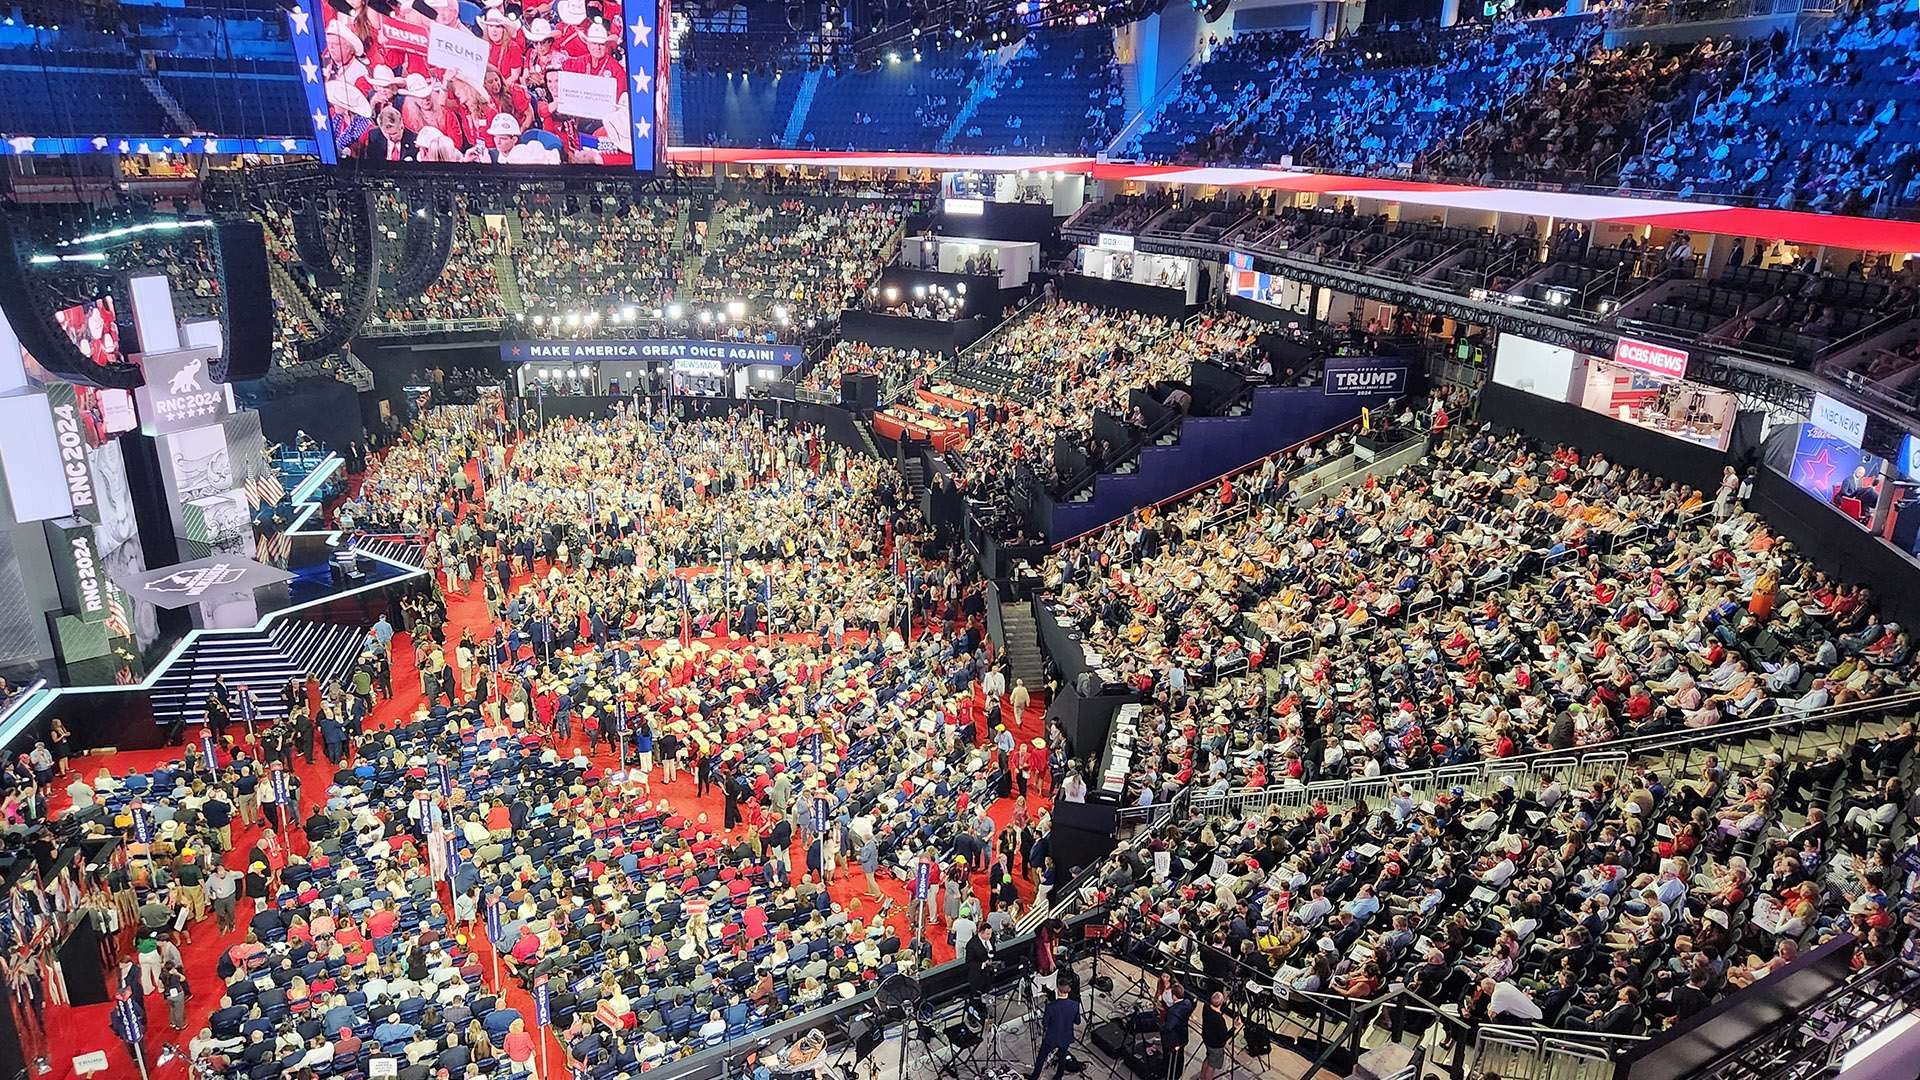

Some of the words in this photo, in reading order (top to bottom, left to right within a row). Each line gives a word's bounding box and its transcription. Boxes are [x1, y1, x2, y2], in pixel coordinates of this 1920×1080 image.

[383, 24, 428, 44] TRUMP
[436, 38, 482, 61] TRUMP
[530, 346, 570, 356] MAKE
[575, 346, 638, 356] AMERICA
[642, 345, 686, 355] GREAT
[690, 346, 725, 357] ONCE
[729, 349, 774, 360] AGAIN!
[677, 360, 719, 369] NEWSMAX
[1628, 347, 1649, 363] CBS
[1649, 352, 1682, 371] NEWS
[1336, 372, 1397, 386] TRUMP
[157, 391, 222, 413] RNC2024
[1824, 407, 1839, 425] NBC
[1839, 414, 1861, 436] NEWS
[54, 404, 94, 507] RNC2024
[72, 536, 103, 613] RNC2024
[274, 770, 284, 803] GEORGIA
[133, 808, 146, 842] VERMONT
[421, 800, 431, 832] NEVADA
[918, 864, 927, 898] ARIZONA
[538, 984, 547, 1025] MONTANA
